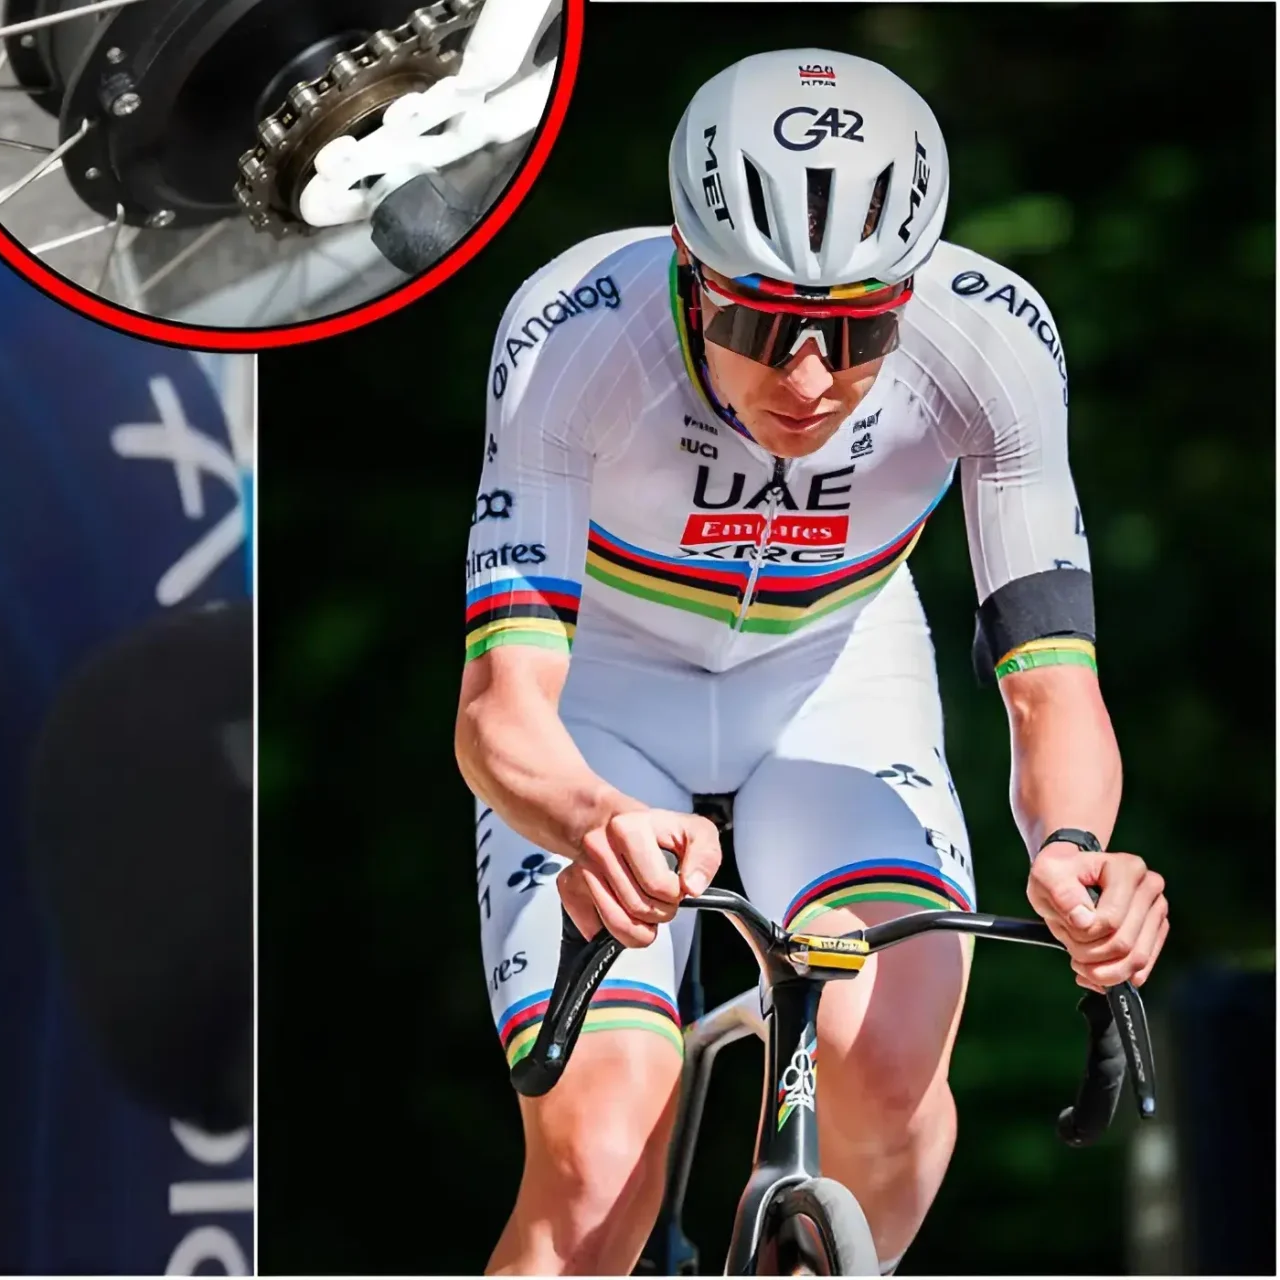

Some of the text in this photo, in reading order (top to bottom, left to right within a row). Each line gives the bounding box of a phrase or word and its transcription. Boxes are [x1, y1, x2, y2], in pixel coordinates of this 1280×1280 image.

[773, 106, 865, 152] G42
[702, 124, 735, 231] MET
[506, 274, 621, 368] Analog
[692, 464, 856, 511] UAE
